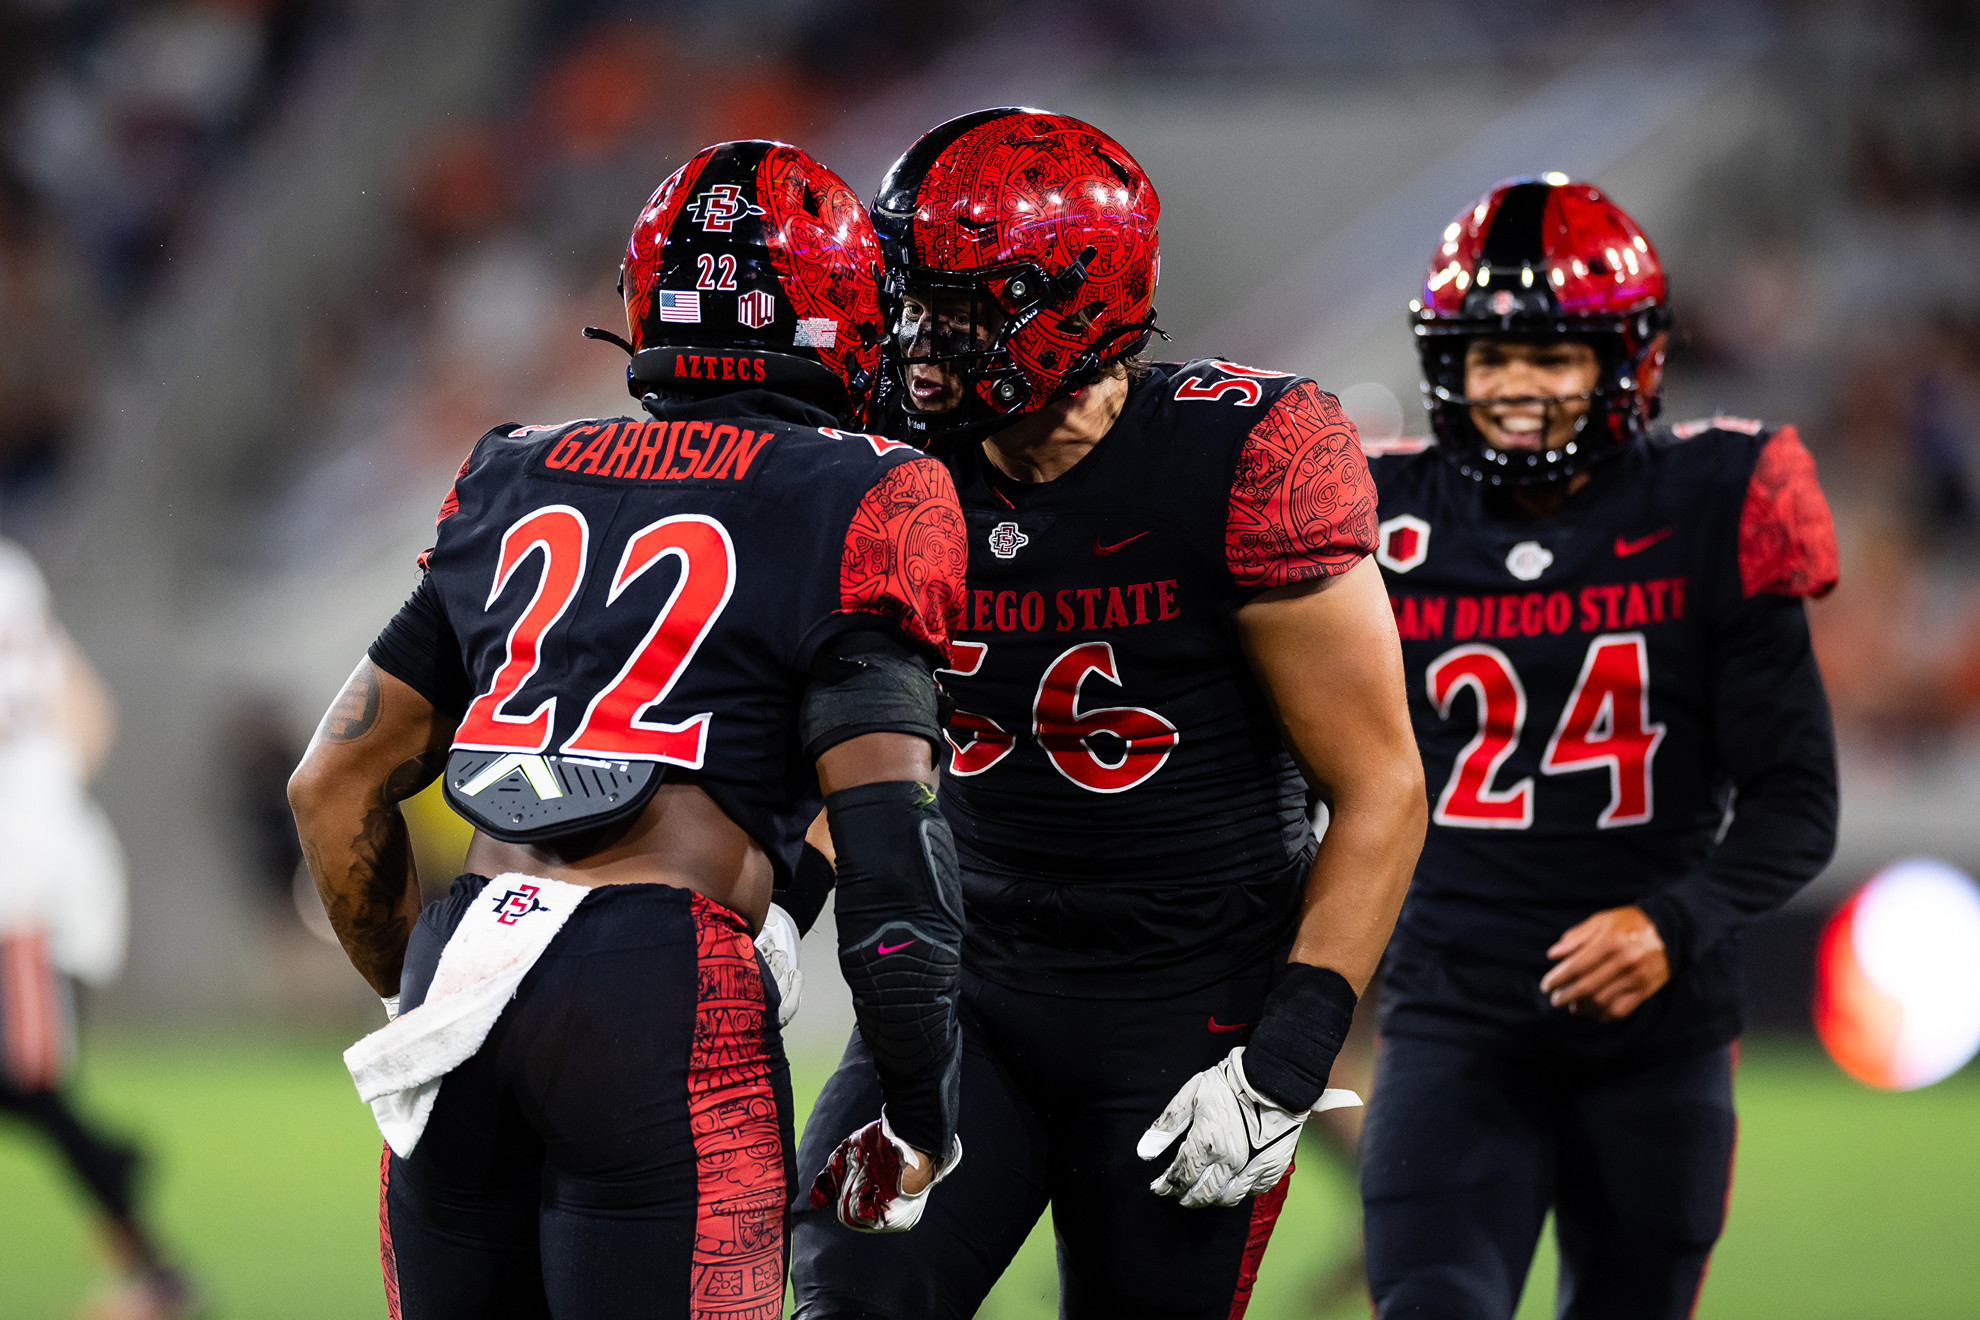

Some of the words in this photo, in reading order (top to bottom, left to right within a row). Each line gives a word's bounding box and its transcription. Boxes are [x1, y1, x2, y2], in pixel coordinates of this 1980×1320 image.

[696, 253, 737, 291] 22
[738, 290, 775, 329] MW
[674, 354, 766, 382] AZTECS
[545, 420, 774, 481] GARRISON
[957, 588, 1045, 632] IEGO
[1055, 579, 1181, 632] STATE
[1453, 589, 1572, 640] DIEGO
[448, 504, 737, 770] 22
[933, 641, 1180, 794] 56
[1425, 632, 1667, 830] 24
